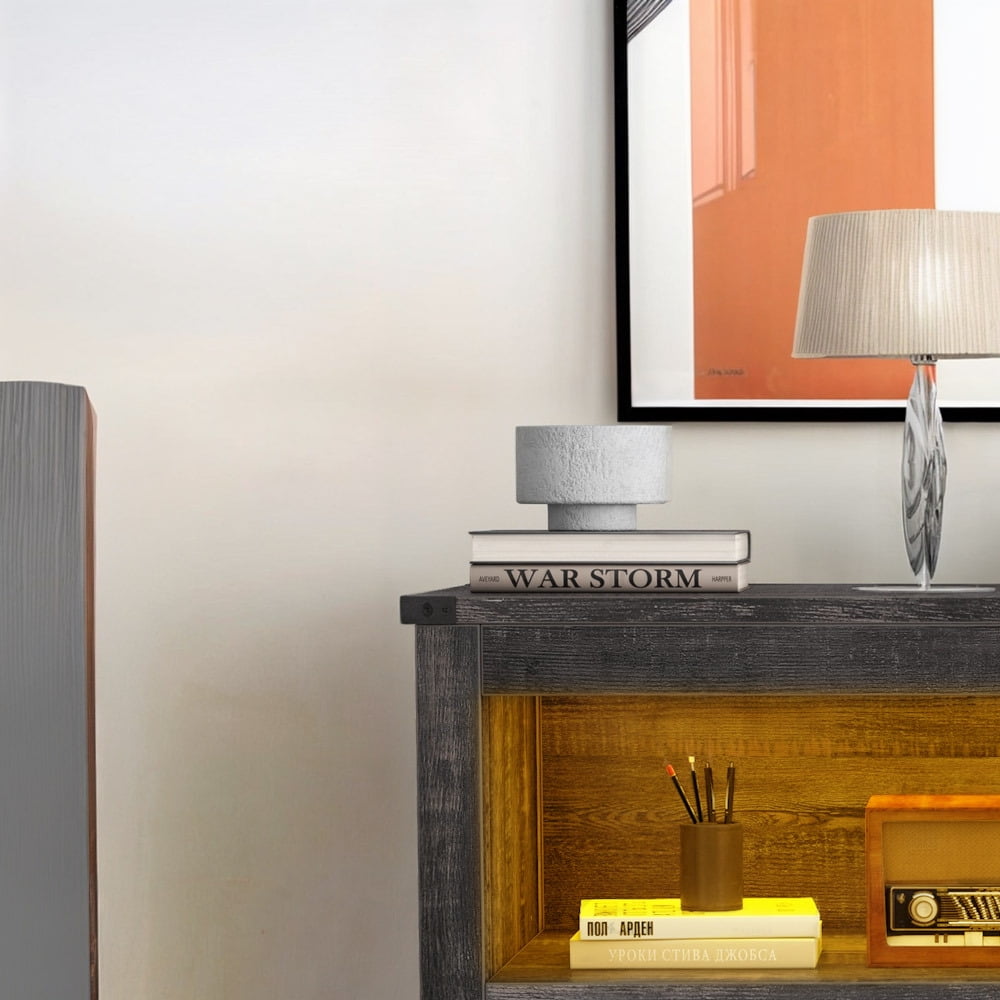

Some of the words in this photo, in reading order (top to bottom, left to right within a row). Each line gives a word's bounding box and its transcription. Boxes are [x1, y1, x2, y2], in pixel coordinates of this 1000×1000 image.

[504, 568, 580, 589] WAR
[590, 568, 702, 589] STORM
[587, 921, 608, 937] ПОЛ
[620, 921, 654, 938] АРДЕН
[608, 948, 657, 962] УРОКИ
[662, 948, 710, 962] СТИВА
[715, 948, 777, 962] ДЖОБСА
